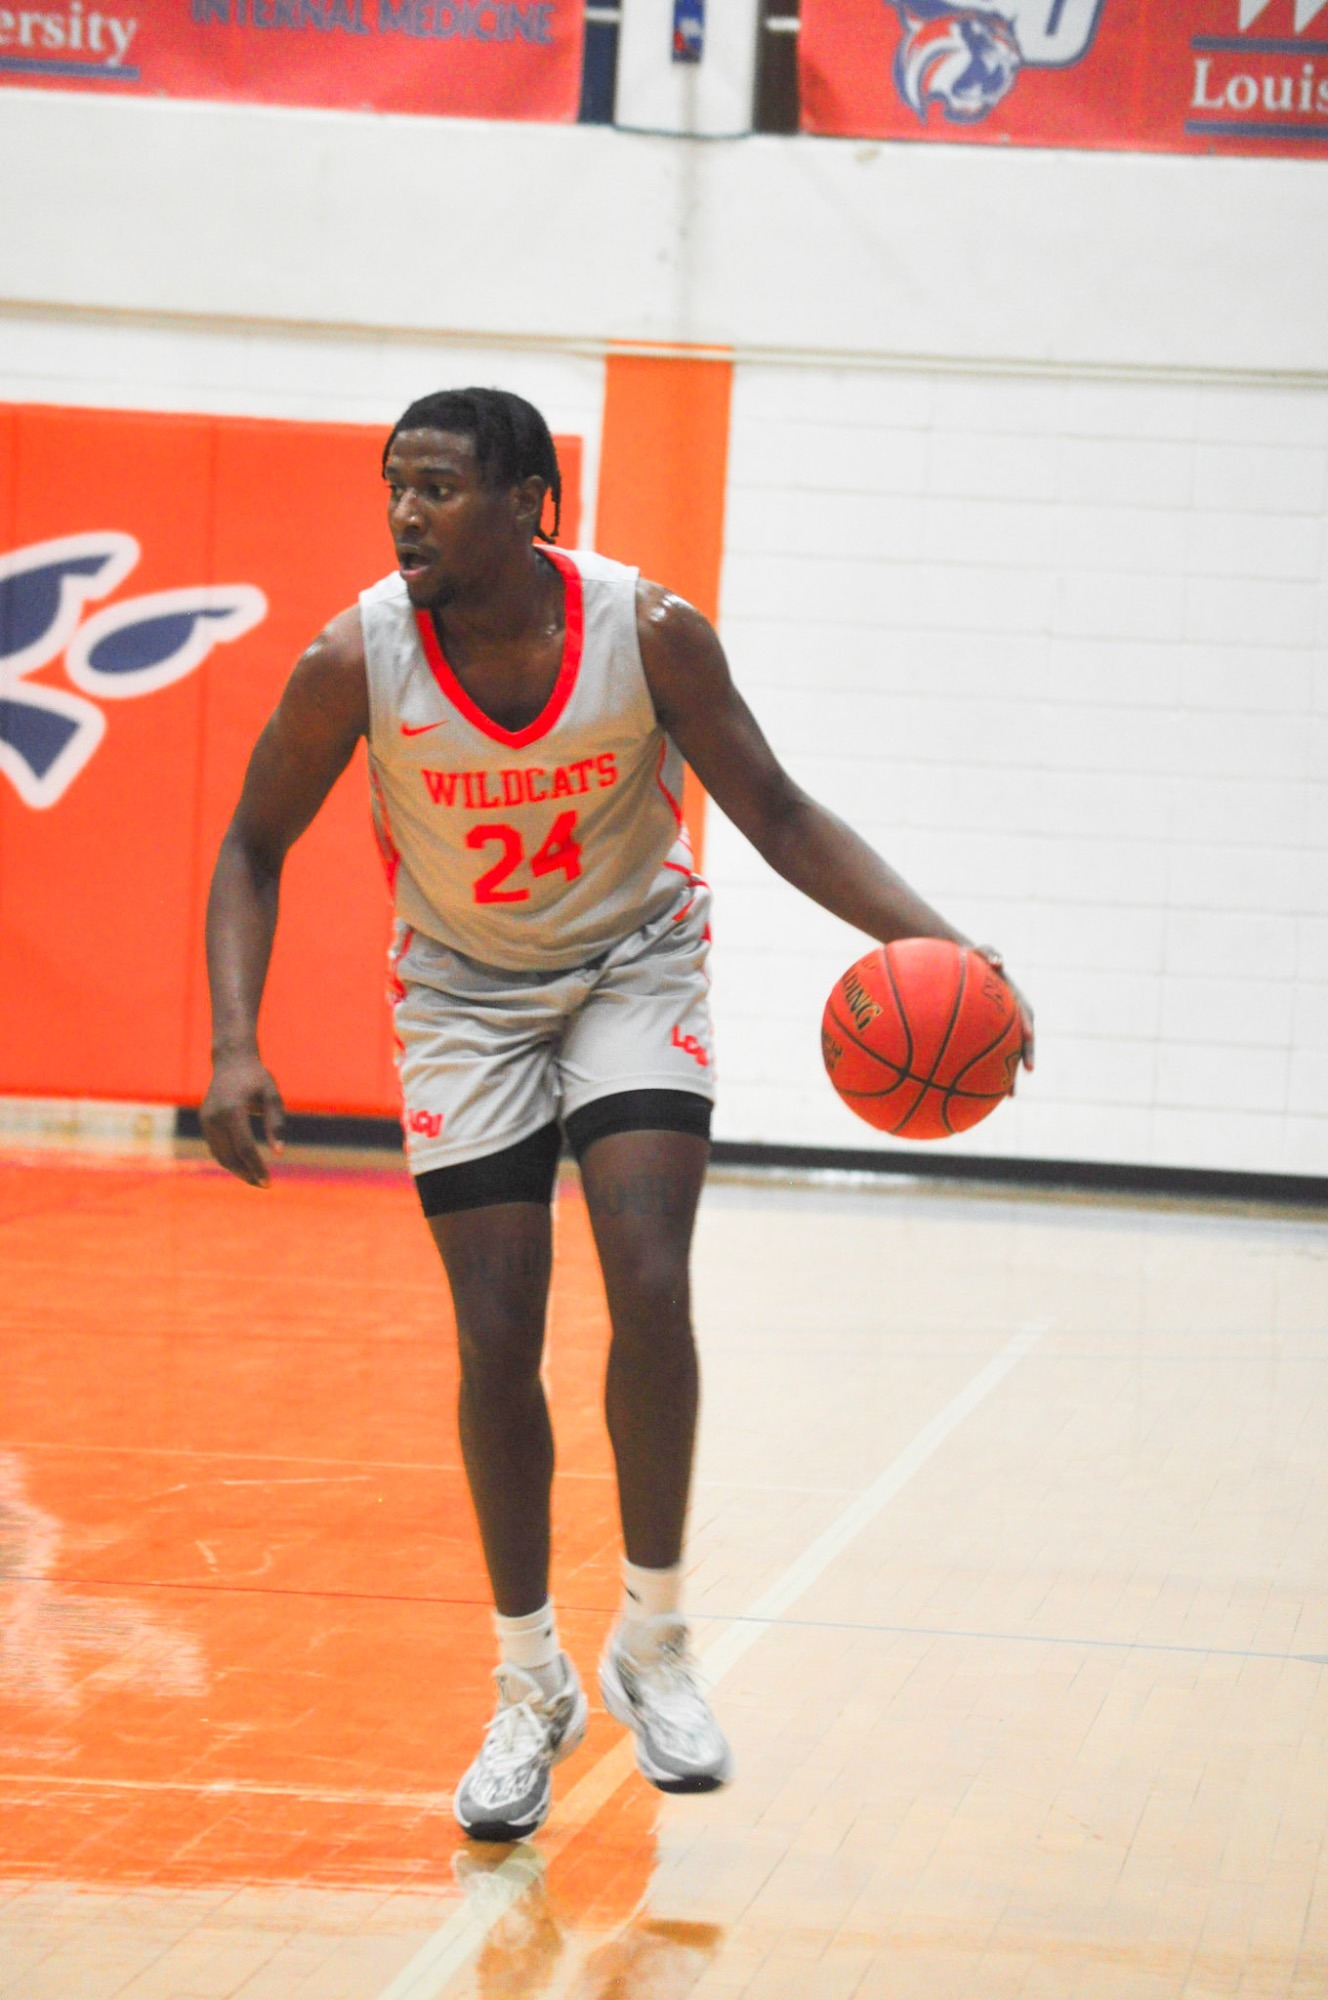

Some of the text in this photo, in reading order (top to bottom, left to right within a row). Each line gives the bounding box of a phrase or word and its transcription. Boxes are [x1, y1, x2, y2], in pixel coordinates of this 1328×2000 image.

[191, 0, 555, 45] INTERNAL MEDICINE
[420, 752, 618, 809] WILDCATS
[464, 810, 583, 904] 24
